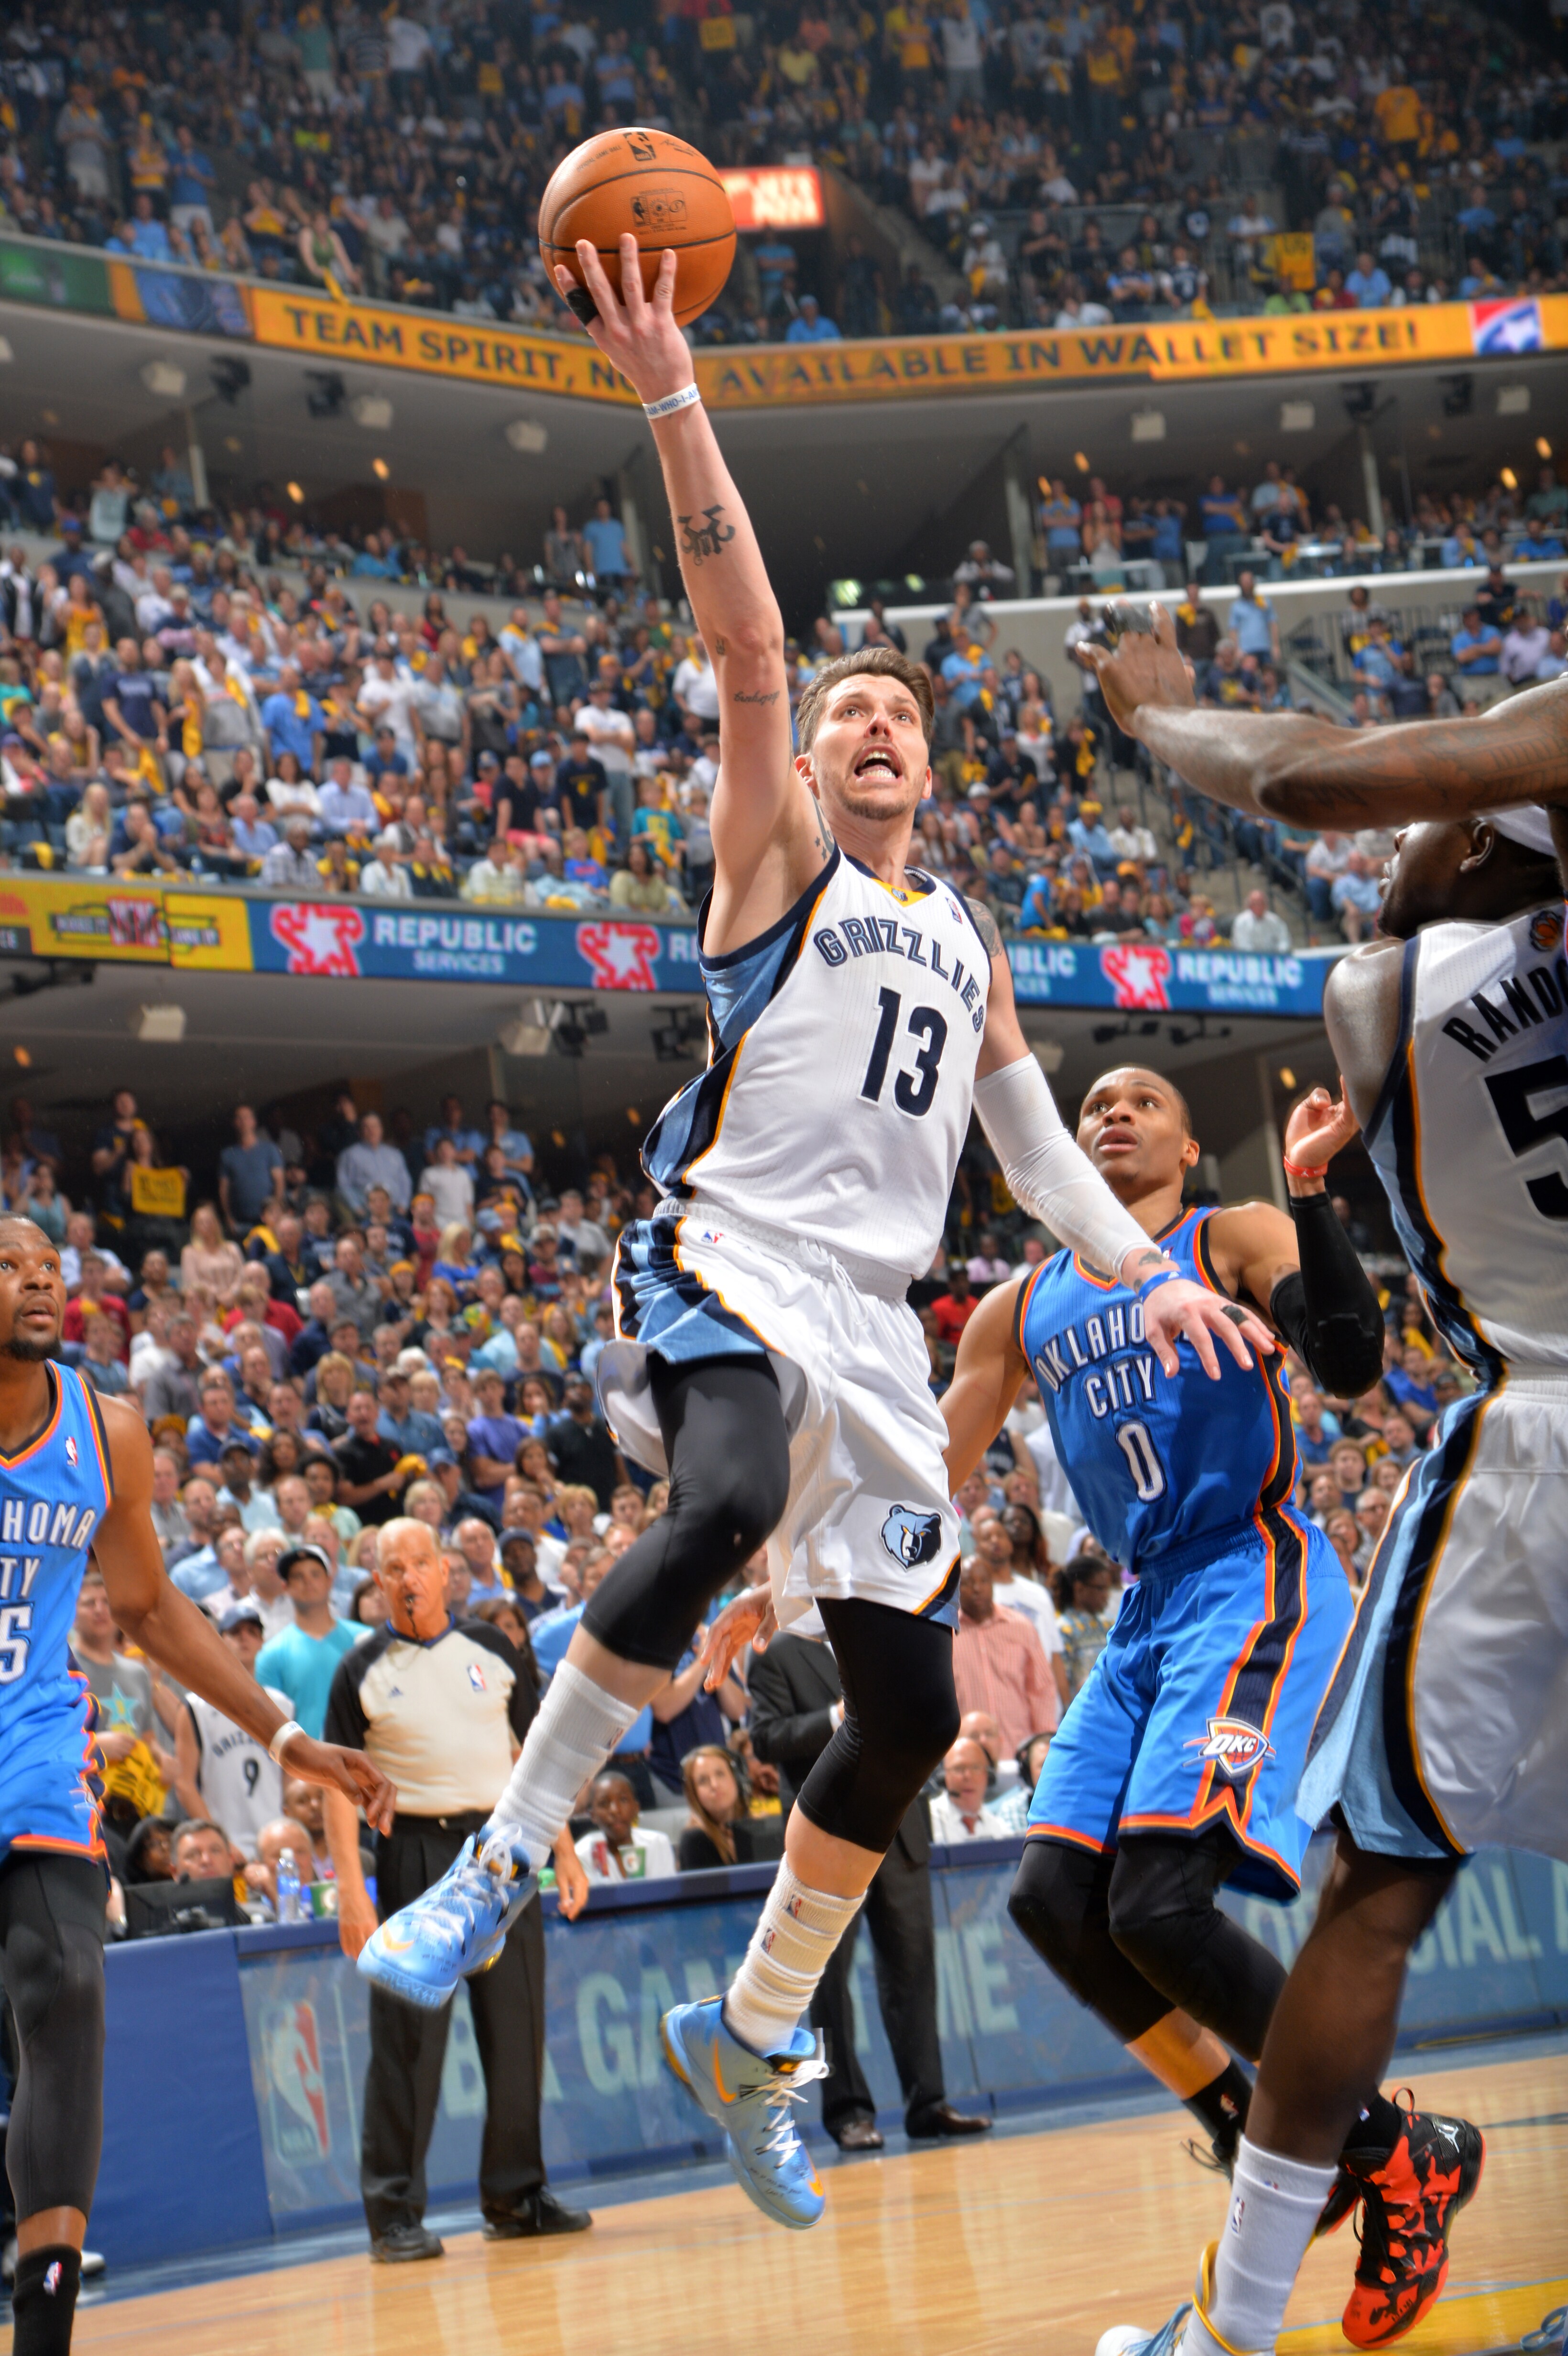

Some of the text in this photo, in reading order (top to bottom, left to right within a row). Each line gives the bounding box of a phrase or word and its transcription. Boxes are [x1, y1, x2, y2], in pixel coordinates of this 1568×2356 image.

[286, 306, 403, 355] TEAM
[420, 331, 573, 388] SPIRIT,
[720, 318, 1418, 394] AVAILABLE IN WALLET SIZE!
[374, 915, 537, 954] REPUBLIC
[813, 916, 985, 1034] GRIZZLIES
[1176, 953, 1303, 988] REPUBLIC
[858, 986, 948, 1118] 13
[1085, 1353, 1157, 1419] CITY
[1116, 1419, 1167, 1503] 0
[244, 1758, 260, 1797] 9
[1203, 1734, 1257, 1755] OKC
